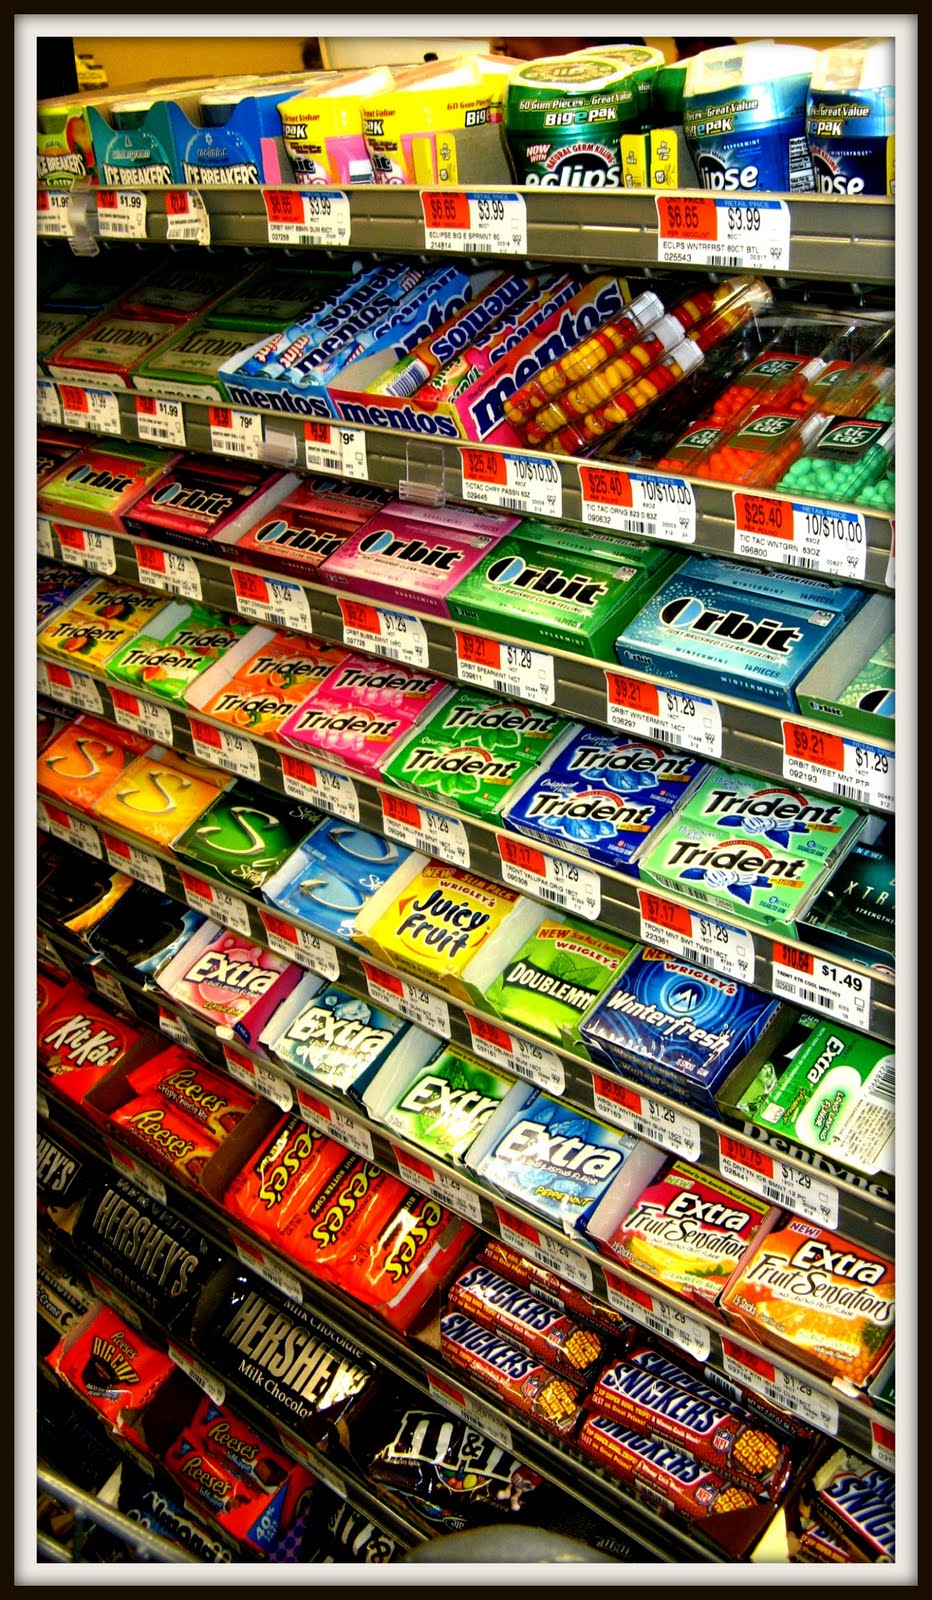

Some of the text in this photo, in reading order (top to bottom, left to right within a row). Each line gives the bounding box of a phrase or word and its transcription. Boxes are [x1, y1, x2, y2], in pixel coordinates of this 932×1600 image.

[531, 101, 551, 109] Gum
[707, 100, 758, 117] Great Value
[821, 105, 869, 117] Great Value
[526, 144, 550, 156] NOW
[723, 139, 760, 150] PEPPERMINT
[48, 154, 86, 175] BREAKERS
[531, 153, 547, 163] WITH
[546, 144, 614, 171] NATURAL GERM KILLING
[103, 165, 172, 184] ICE BREAKERS
[184, 165, 259, 184] ICE BREAKERS
[120, 195, 141, 209] $1.99
[310, 198, 331, 216] $3.99
[432, 199, 456, 220] $6.65
[478, 201, 504, 221] $3.99
[667, 206, 699, 228] $6.65
[728, 208, 761, 231] $3.99
[664, 253, 691, 262] 025543
[89, 326, 158, 346] ALTOIDS
[279, 335, 310, 365] mint
[469, 280, 624, 441] mentos
[159, 400, 179, 417] $1.99
[227, 385, 332, 418] mentos
[240, 416, 252, 429] 79¢
[337, 400, 459, 439] mentos
[753, 422, 780, 434] tac
[766, 414, 784, 426] tic
[844, 426, 868, 437] tic
[832, 433, 860, 445] tac
[468, 454, 498, 474] $25.40
[514, 461, 558, 484] 10/$10.00
[65, 465, 135, 493] Orbit
[588, 473, 622, 497] $25.40
[152, 482, 232, 518] Orbit
[640, 481, 692, 505] 10/$10.00
[744, 503, 783, 529] $25.40
[255, 520, 347, 556] Orbit
[739, 534, 752, 543] TIC
[755, 536, 767, 546] TAC
[805, 515, 862, 543] 10/$10.00
[359, 530, 464, 572] Orbit
[740, 545, 768, 558] 096800
[271, 584, 292, 602] $1.29
[486, 555, 608, 607] Orbit
[51, 623, 124, 641] Trident
[385, 612, 406, 633] $1.29
[659, 596, 803, 655] Orbit
[539, 630, 585, 646] SPEARMINT
[667, 628, 683, 637] JUST
[684, 632, 713, 645] BRUSHED
[714, 638, 736, 651] CLEAN
[120, 650, 203, 669] Trident
[460, 661, 476, 672] ORBIT
[507, 648, 532, 669] $1.29
[675, 646, 728, 665] WINTERMINT
[336, 669, 438, 693] Trident
[753, 665, 781, 679] PIECES
[615, 681, 641, 700] $9.21
[720, 676, 783, 696] WINTERMINT
[667, 693, 695, 716] $1.29
[809, 700, 843, 716] Orbit
[297, 711, 399, 736] Trident
[448, 706, 559, 733] Trident
[611, 707, 629, 717] ORBIT
[630, 710, 668, 727] WINTERMINT
[793, 729, 825, 755] $9.21
[407, 749, 521, 779] Trident
[569, 746, 695, 775] Trident
[788, 758, 870, 787] ORBIT SWEET MNT PTP
[855, 748, 889, 774] $1.29
[789, 769, 818, 784] 092193
[527, 794, 655, 826] Trident
[704, 789, 842, 827] Trident
[668, 840, 808, 880] Trident
[855, 848, 883, 861] NEW!
[553, 859, 579, 881] $1.29
[424, 868, 515, 901] NEW SLIM PACK
[439, 880, 496, 909] WRIGLEY'S
[413, 890, 489, 932] Juicy
[397, 913, 470, 958] Fruit
[538, 928, 571, 939] NEW
[700, 920, 728, 944] $1.29
[555, 941, 620, 970] WRIGLEY'S
[184, 951, 280, 996] Extra
[665, 962, 736, 995] WRIGLEY'S
[821, 964, 862, 991] $1.49
[285, 1006, 395, 1051] Extra
[606, 990, 731, 1054] Winterfresh
[807, 1035, 845, 1085] Extra
[162, 1070, 227, 1113] Reese's
[129, 1109, 194, 1158] Reese's
[495, 1121, 624, 1180] Extra
[664, 1176, 694, 1190] NEW!
[781, 1163, 812, 1189] $1.29
[624, 1204, 673, 1239] Fruit
[664, 1192, 750, 1232] Extra
[789, 1221, 821, 1238] NEW!
[92, 1188, 199, 1297] HERSHEY'S
[791, 1239, 887, 1286] Extra
[458, 1266, 566, 1331] SNICKERS
[747, 1253, 896, 1323] Fruit Sensations
[660, 1303, 686, 1324] $1.29
[110, 1331, 137, 1360] Reese's
[441, 1313, 542, 1379] SNICKERS
[92, 1336, 141, 1384] BIG CUP
[237, 1358, 264, 1382] Milk
[601, 1360, 731, 1435] SNICKERS
[206, 1422, 260, 1460] Reese's
[181, 1455, 231, 1493] Reese's
